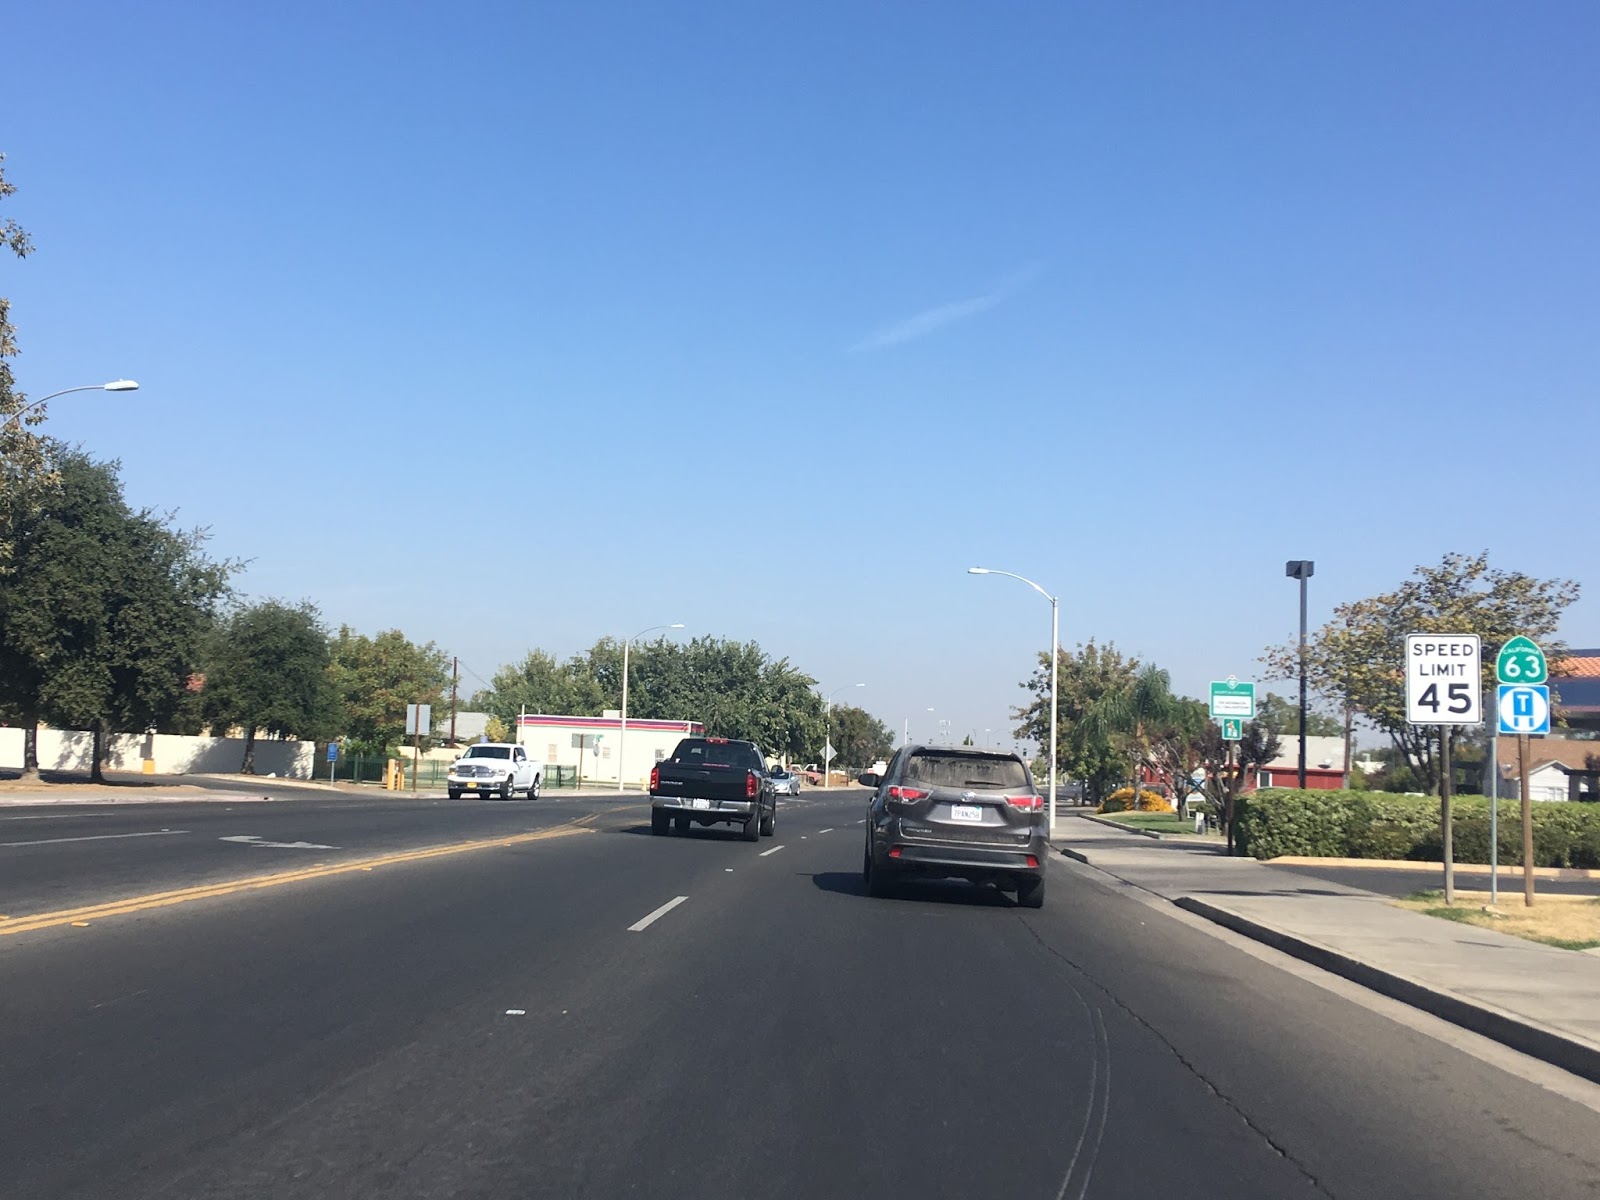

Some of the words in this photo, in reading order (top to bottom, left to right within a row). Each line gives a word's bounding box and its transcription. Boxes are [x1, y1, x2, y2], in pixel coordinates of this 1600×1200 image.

[1412, 643, 1474, 656] SPEED
[1419, 663, 1467, 676] LIMIT
[1505, 655, 1541, 678] 63
[1417, 683, 1472, 714] 45
